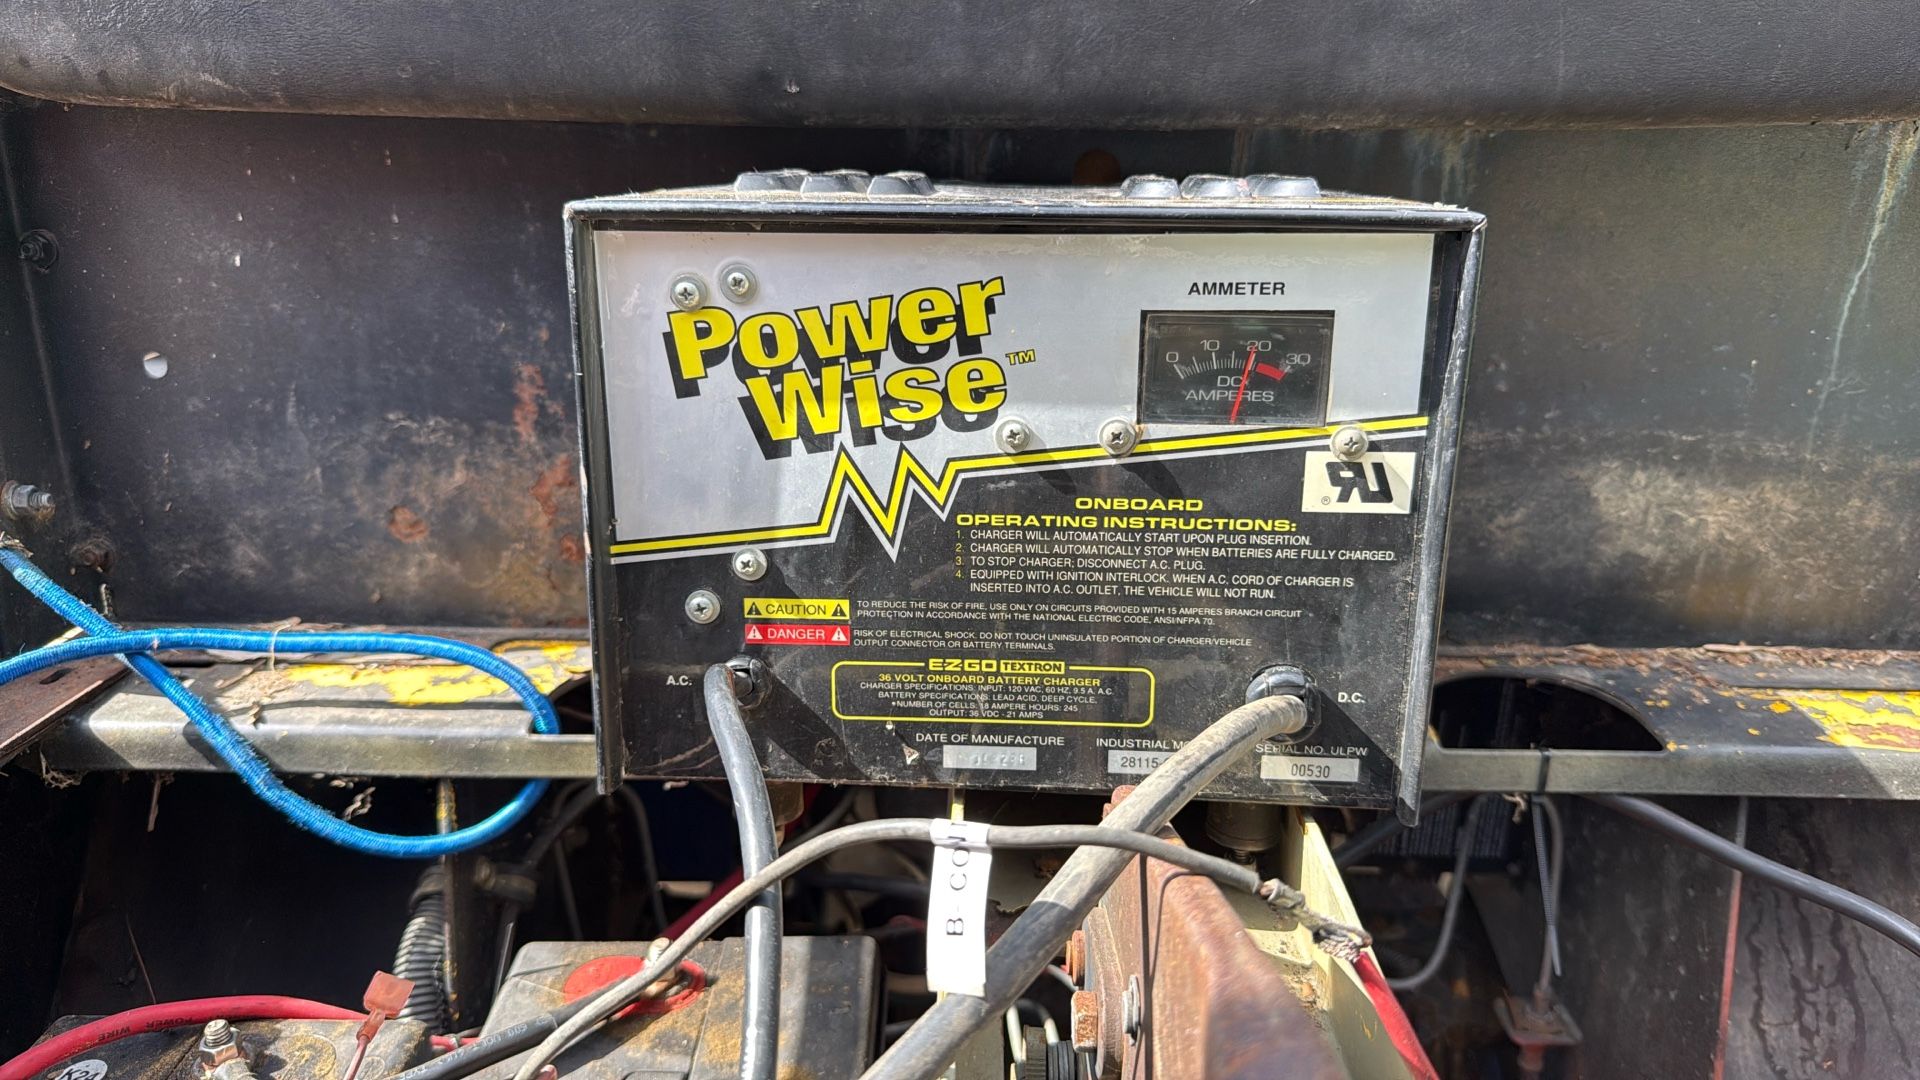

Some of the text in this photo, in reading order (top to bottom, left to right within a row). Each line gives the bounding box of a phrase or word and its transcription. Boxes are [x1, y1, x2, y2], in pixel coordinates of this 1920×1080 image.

[1188, 282, 1286, 296] AMMETER
[666, 275, 1006, 382] Power
[1200, 340, 1272, 351] 10 20
[1166, 351, 1311, 365] 0 30
[1217, 375, 1244, 388] DC
[744, 356, 1008, 442] Wise
[1185, 390, 1274, 402] AMPERES
[1075, 497, 1204, 511] ONBOARD
[956, 514, 1296, 532] OPERATING INSTRUCTIONS:
[956, 530, 1311, 546] 1. CHARGER WILL AUTOMATICALLY START UPON PLUG INSERTION.
[955, 543, 1396, 561] 2. CHARGER WILL AUTOMATICALLY STOP WHEN BATTERIES ARE FULLY CHARGED.
[955, 557, 1205, 571] 3. TO STOP CHARGER; DISCONNECT A.C. PLUG.
[955, 570, 1354, 587] 4. EQUIPPED WITH IGNITION INTERLOCK. WHEN A.C. CORD OF CHARGER IS
[970, 583, 1275, 599] INSERTED INTO A.C. OUTLET, THE VEHICLE WILL NOT RUN.
[765, 604, 827, 616] CAUTION
[857, 601, 869, 609] TO
[871, 601, 906, 610] REDUCE
[910, 602, 926, 610] THE
[928, 602, 948, 610] RISK
[950, 602, 963, 611] OF
[989, 603, 1007, 612] USE
[1009, 604, 1033, 612] ONLY
[1034, 604, 1048, 613] ON
[1050, 605, 1092, 614] CIRCUITS
[1094, 606, 1140, 614] PROVIDED
[1141, 607, 1164, 615] WITH
[1167, 607, 1176, 615] 15
[1178, 607, 1222, 616] AMPERES
[1224, 608, 1263, 617] BRANCH
[1264, 609, 1301, 618] CIRCUIT
[856, 610, 913, 619] PROTECTION
[914, 611, 924, 619] IN
[925, 611, 986, 621] ACCORDANCE
[988, 613, 1011, 621] WITH
[1013, 613, 1030, 622] THE
[1032, 613, 1076, 623] NATIONAL
[1078, 614, 1121, 624] ELECTRIC
[1202, 617, 1215, 625] 70.
[767, 628, 825, 640] DANGER
[853, 629, 873, 638] RISK
[875, 630, 887, 638] OF
[889, 630, 942, 640] ELECTRICAL
[979, 632, 992, 641] DO
[994, 632, 1012, 641] NOT
[1015, 633, 1045, 642] TOUCH
[1047, 634, 1109, 643] UNINSULATED
[1110, 635, 1151, 644] PORTION
[1152, 636, 1165, 644] OF
[1166, 636, 1251, 646] CHARGER/VEHICLE
[852, 639, 1056, 651] OUTPUT CONNECTOR OR BATTERY TERMINALS.
[1002, 661, 1063, 674] TEXTRON
[666, 675, 693, 686] A.C.
[859, 682, 902, 690] CHARGER
[878, 674, 1100, 687] 36 VOLT ONBOARD BATTERY CHARGER
[877, 692, 916, 700] BATTERY
[1337, 692, 1366, 704] D.C.
[896, 701, 933, 709] NUMBER
[968, 710, 979, 718] 36
[1006, 711, 1015, 719] 21
[1018, 711, 1043, 719] AMPS
[915, 732, 1064, 746] DATE OF MANUFACTURE
[1096, 737, 1170, 750] INDUSTRIAL
[1255, 744, 1301, 754] SERIAL
[1330, 746, 1368, 756] ULPW
[1291, 763, 1331, 779] 00530
[147, 1017, 193, 1030] POWER
[98, 1025, 131, 1042] WIRE
